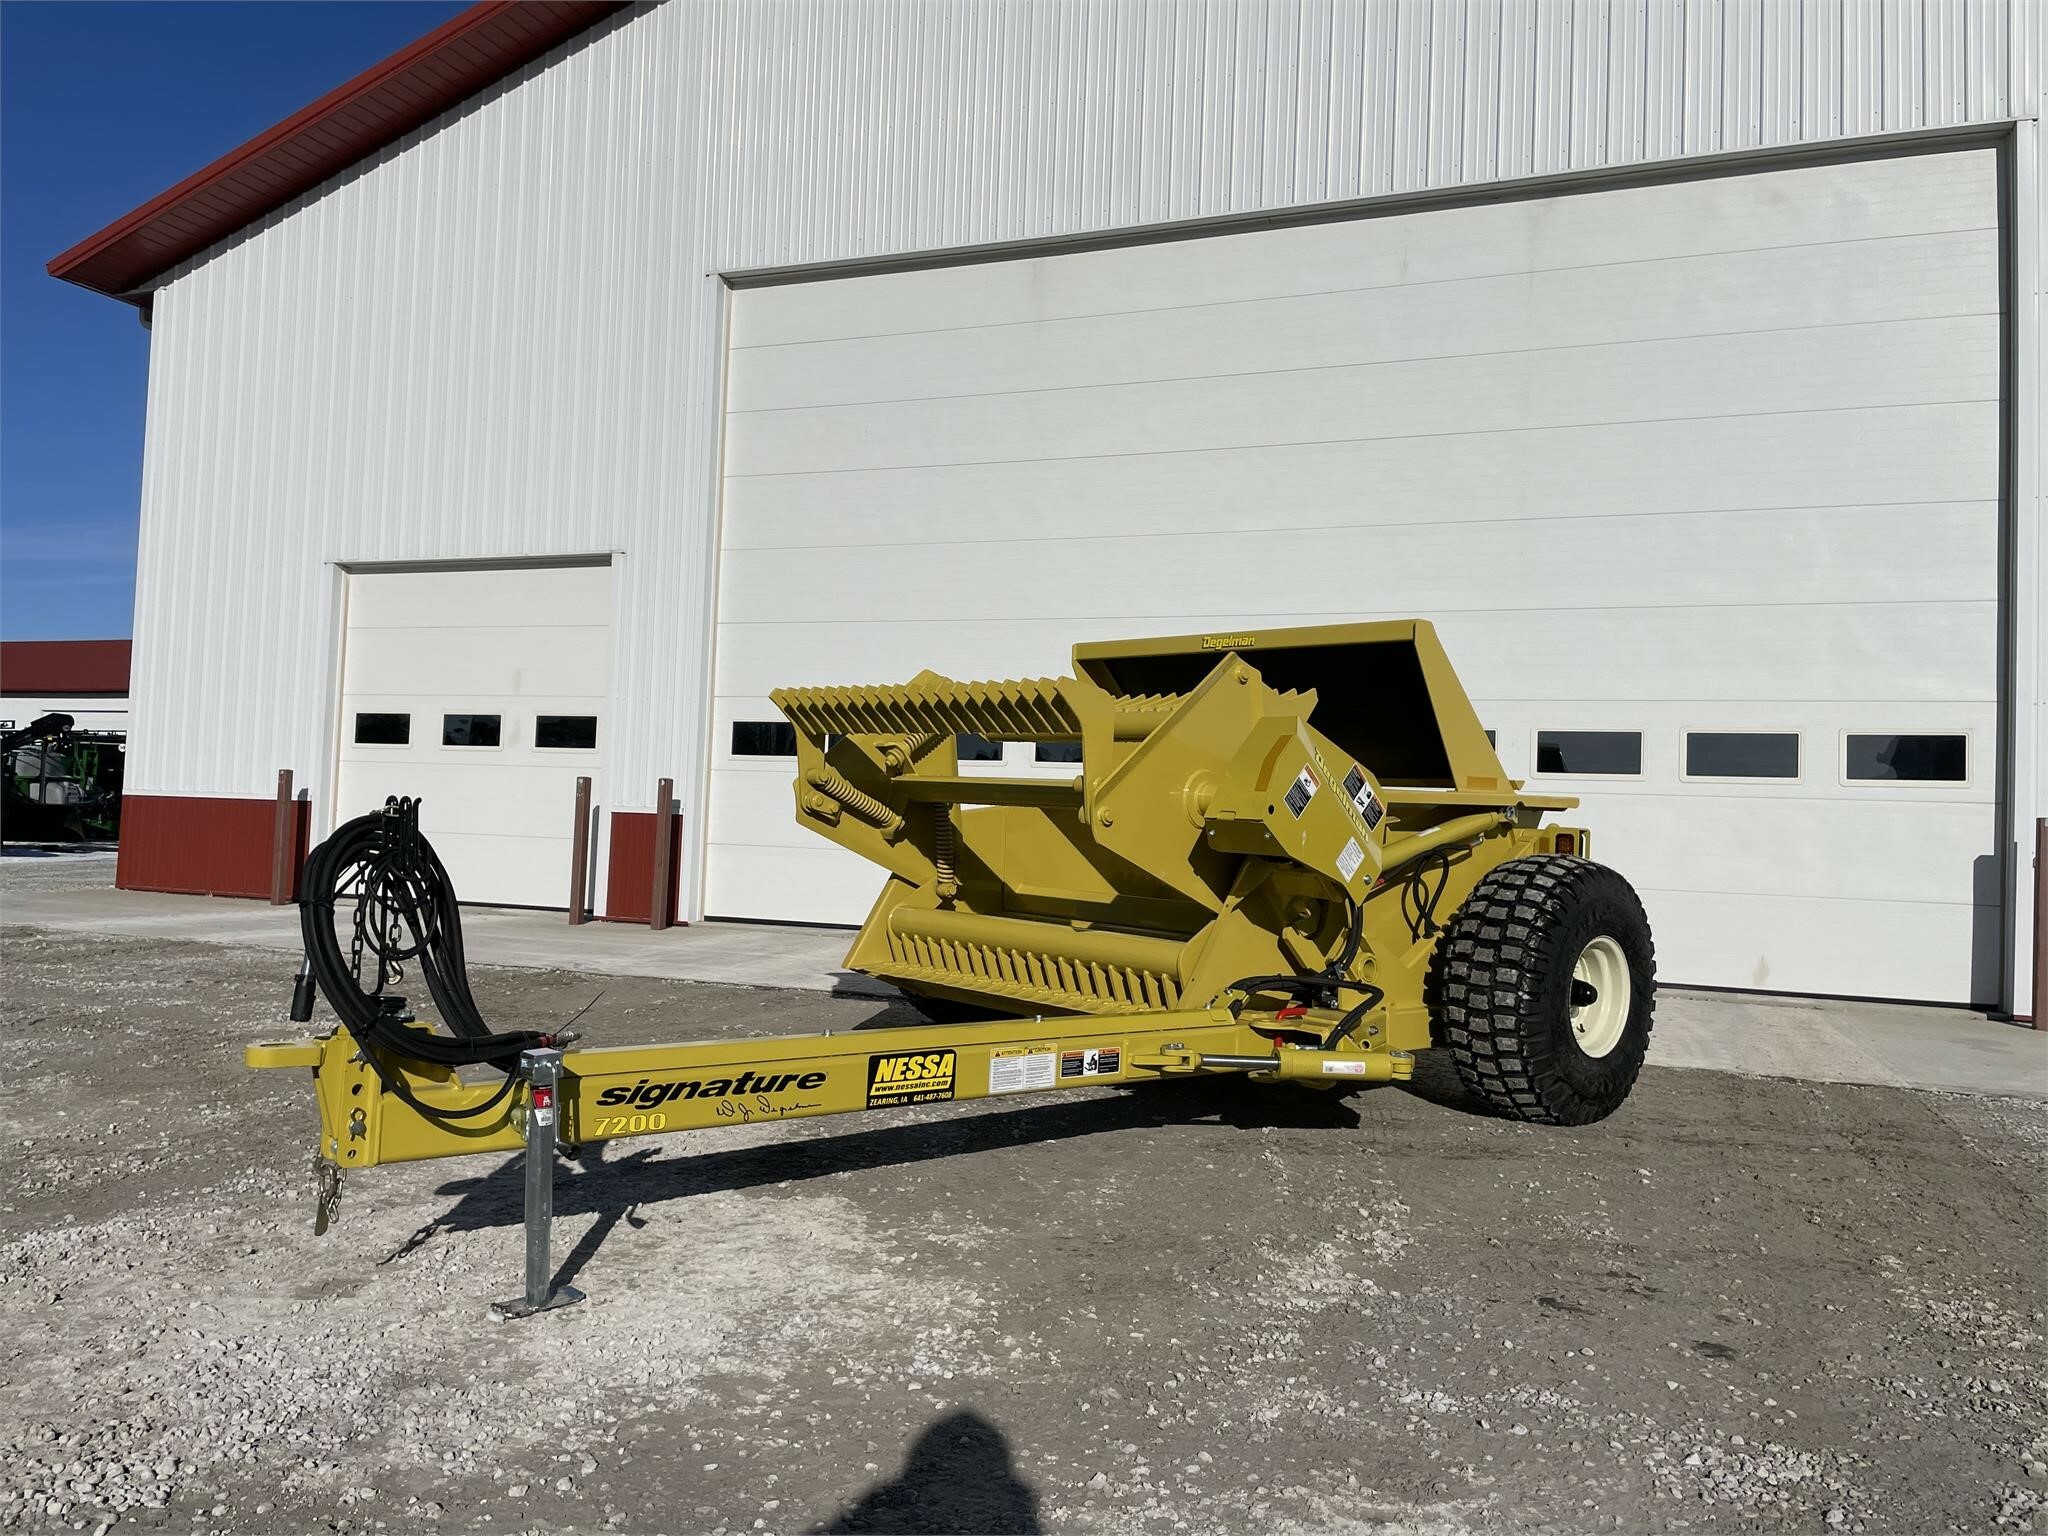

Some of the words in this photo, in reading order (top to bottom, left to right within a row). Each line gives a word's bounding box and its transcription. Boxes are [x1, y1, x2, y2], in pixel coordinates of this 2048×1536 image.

[1202, 635, 1256, 650] Degelman
[1314, 747, 1369, 842] Degelman
[874, 1053, 955, 1082] NESSA
[596, 1071, 827, 1110] signature
[874, 1080, 949, 1093] www.nessainc.com
[869, 1096, 900, 1106] ZEARING,
[900, 1095, 908, 1103] IA
[593, 1113, 667, 1137] 7200
